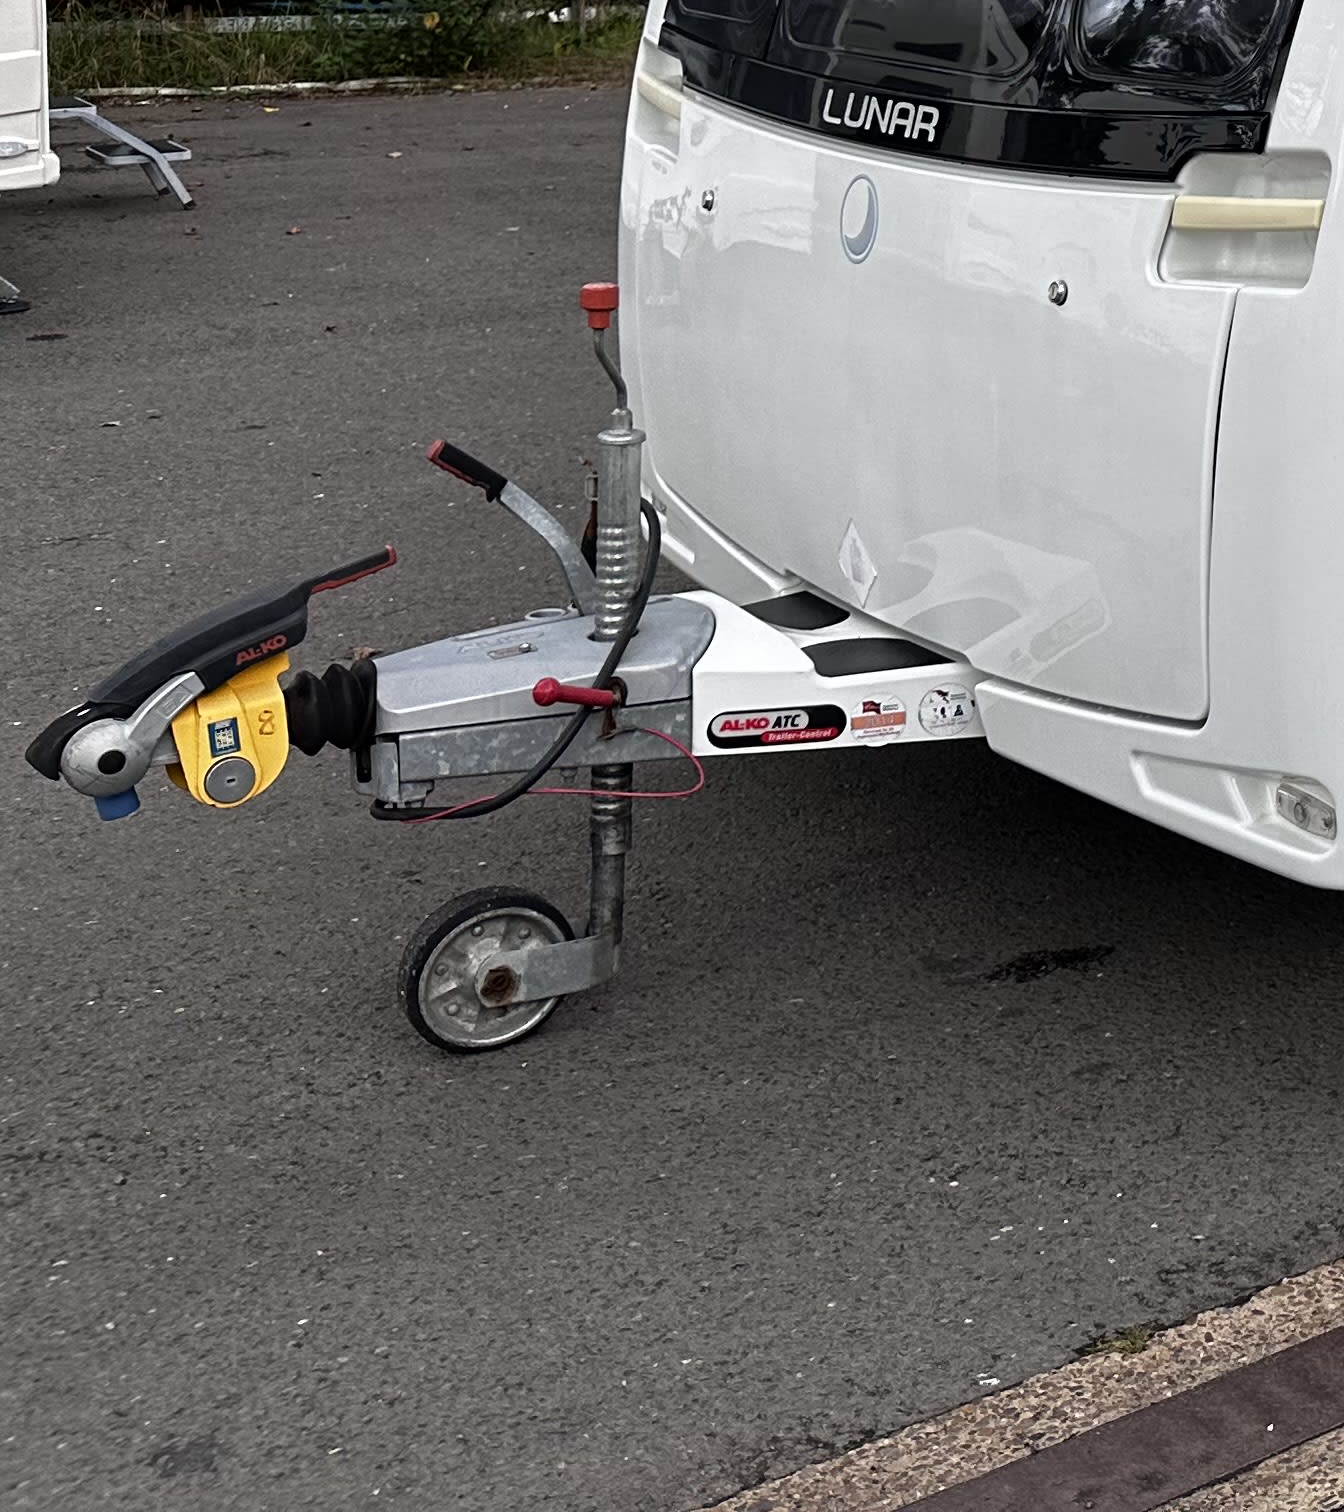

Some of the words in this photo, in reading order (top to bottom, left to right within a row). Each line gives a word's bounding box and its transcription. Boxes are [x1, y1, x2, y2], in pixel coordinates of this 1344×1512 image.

[822, 88, 940, 143] LUNAR
[235, 634, 288, 666] AL-KO
[719, 717, 770, 732] AL-KO
[771, 713, 802, 729] ATC
